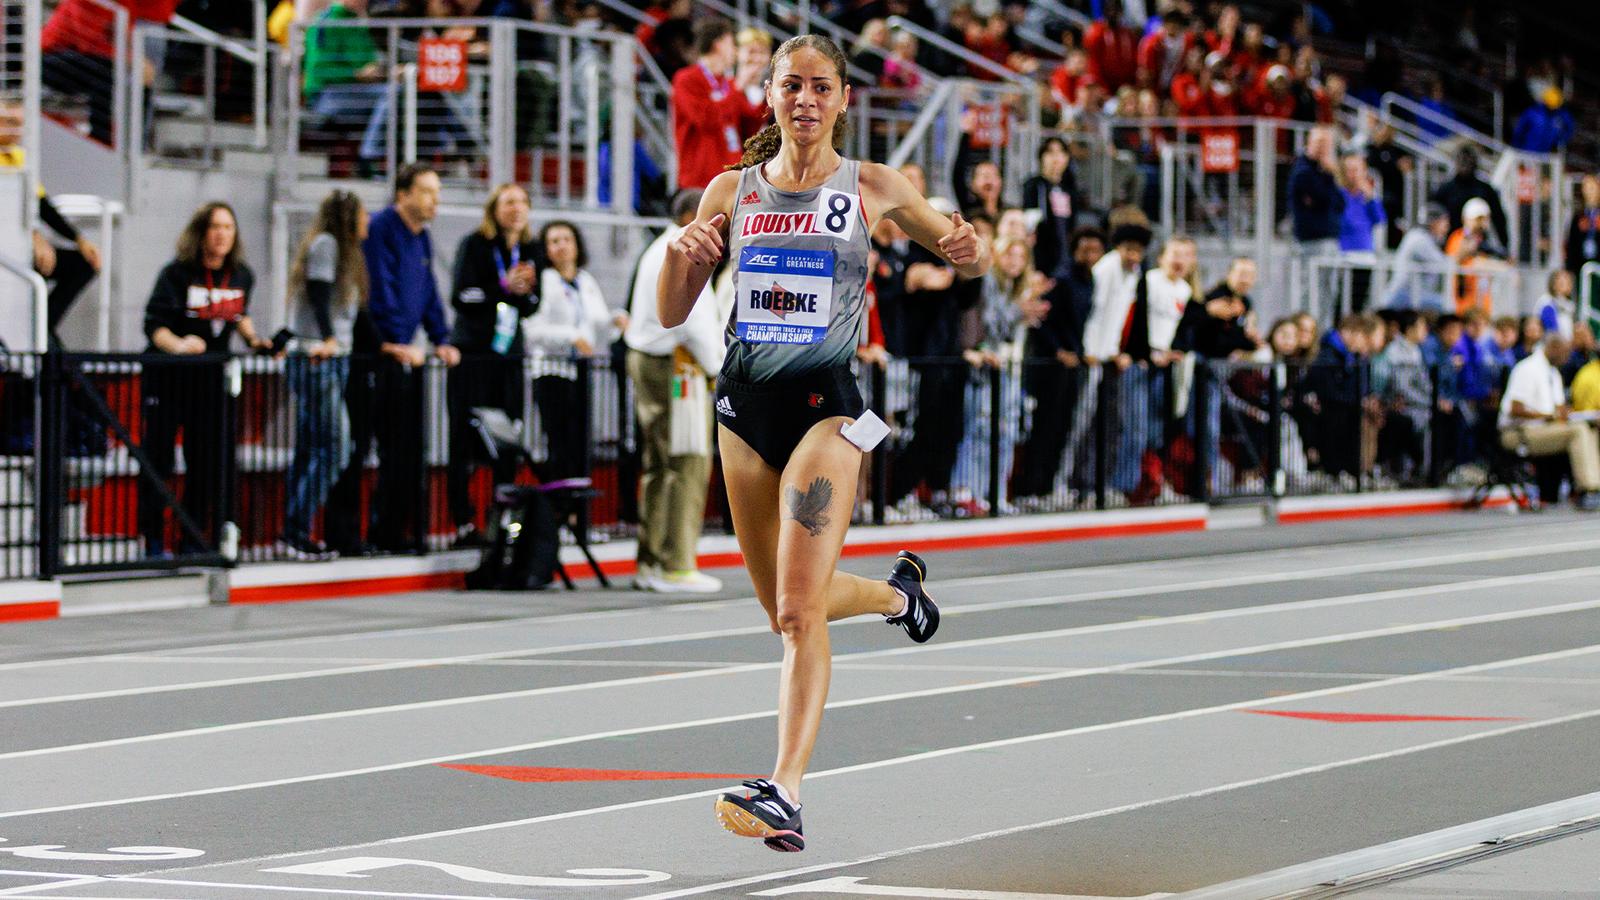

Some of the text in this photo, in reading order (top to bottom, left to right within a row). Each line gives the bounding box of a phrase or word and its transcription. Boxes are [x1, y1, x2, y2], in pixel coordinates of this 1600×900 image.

[825, 193, 852, 233] 8
[748, 254, 779, 266] ACC
[786, 260, 824, 269] GREATNESS
[750, 289, 818, 313] ROEBKE
[746, 330, 813, 343] CHAMPIONSHIPS
